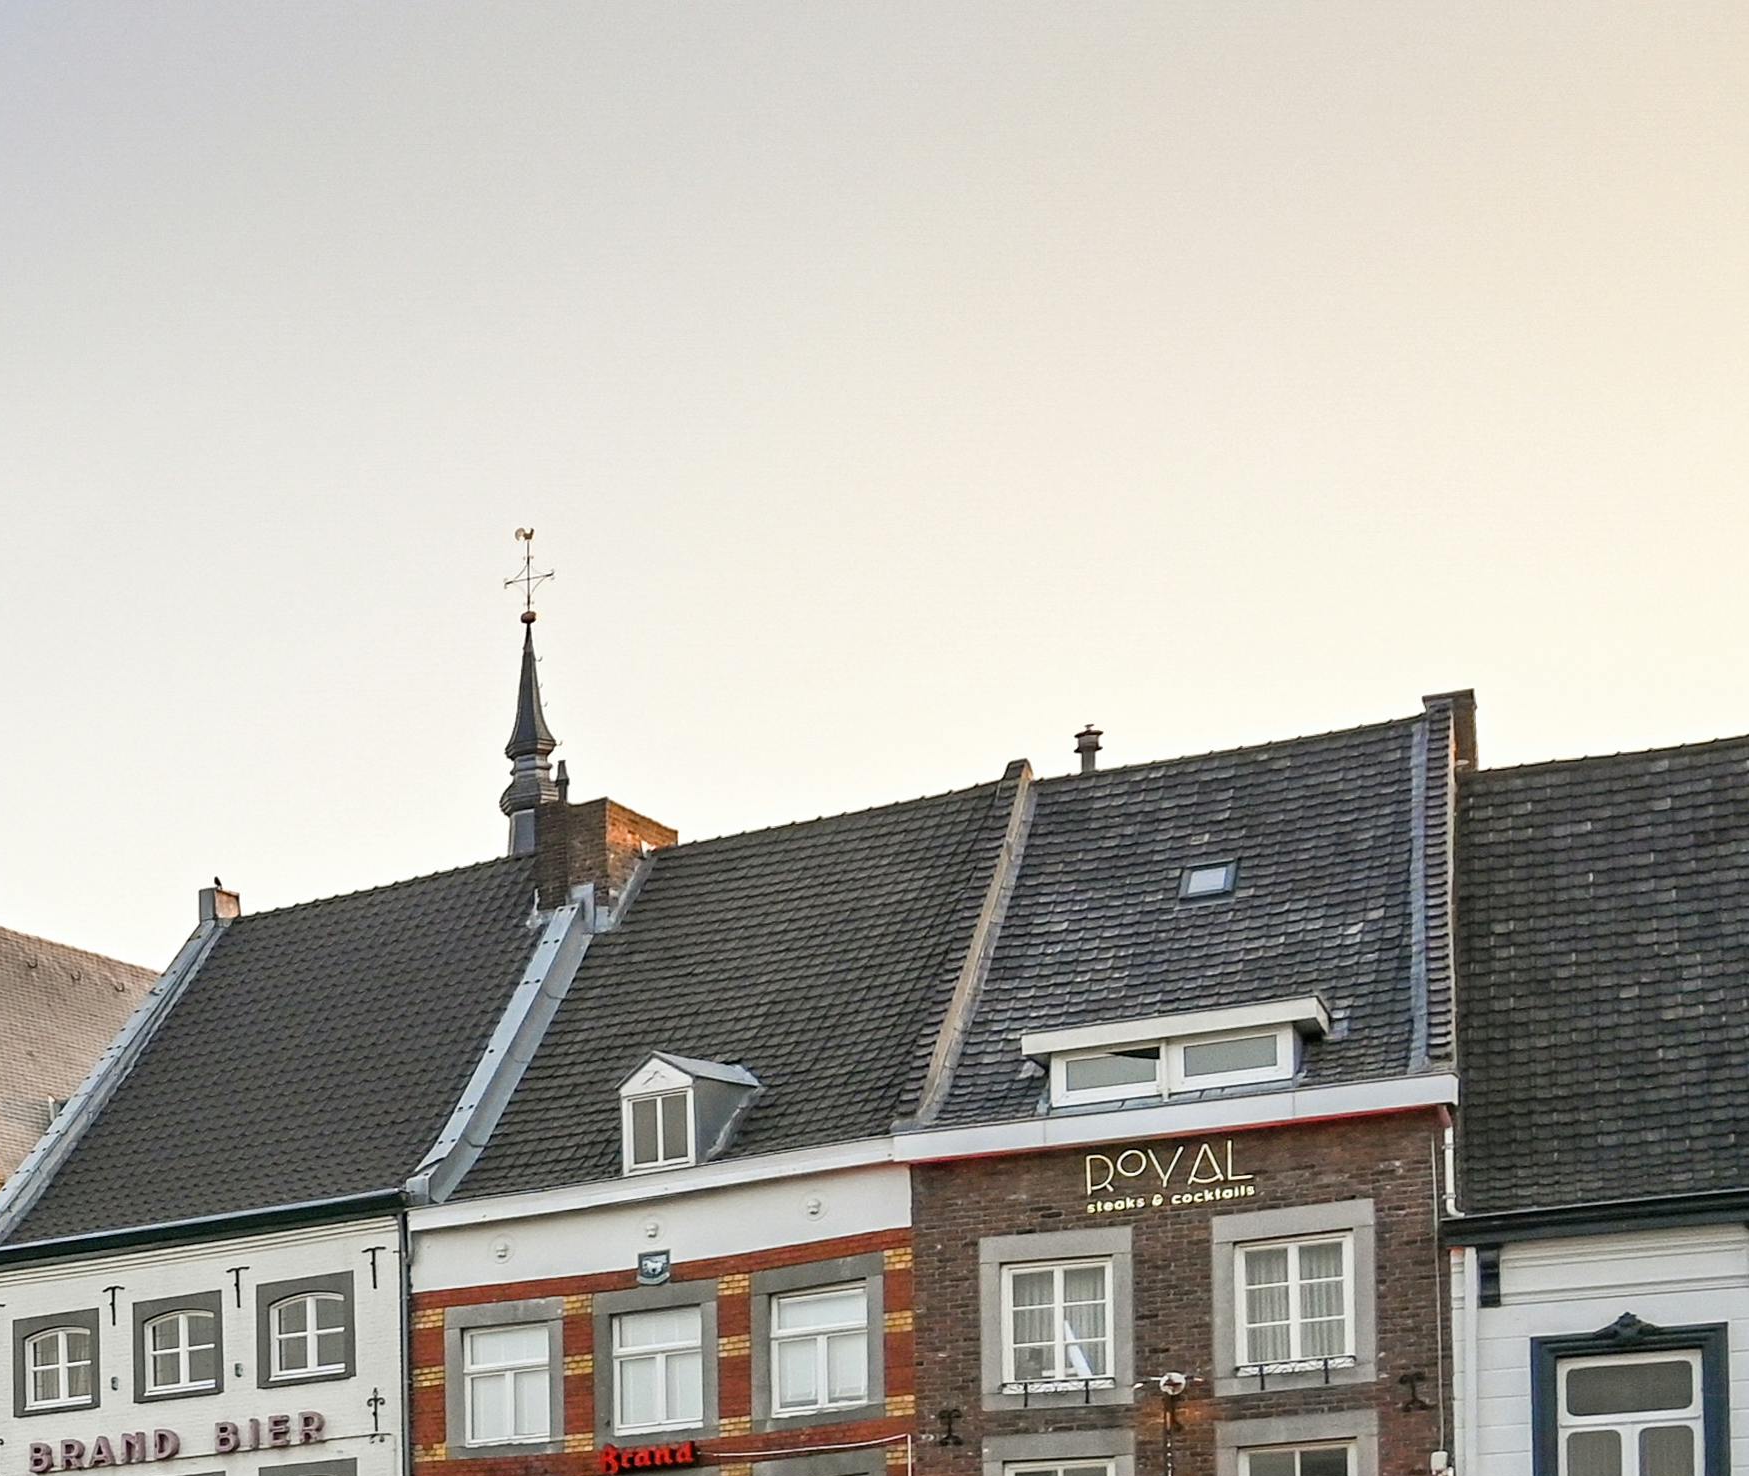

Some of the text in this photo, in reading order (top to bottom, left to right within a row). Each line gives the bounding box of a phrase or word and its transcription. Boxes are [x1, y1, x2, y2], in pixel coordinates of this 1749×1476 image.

[1085, 1139, 1254, 1196] ROYAL
[1086, 1185, 1255, 1214] steaks & cocktails
[29, 1410, 326, 1474] BRAND BIER
[598, 1440, 695, 1475] Brand
